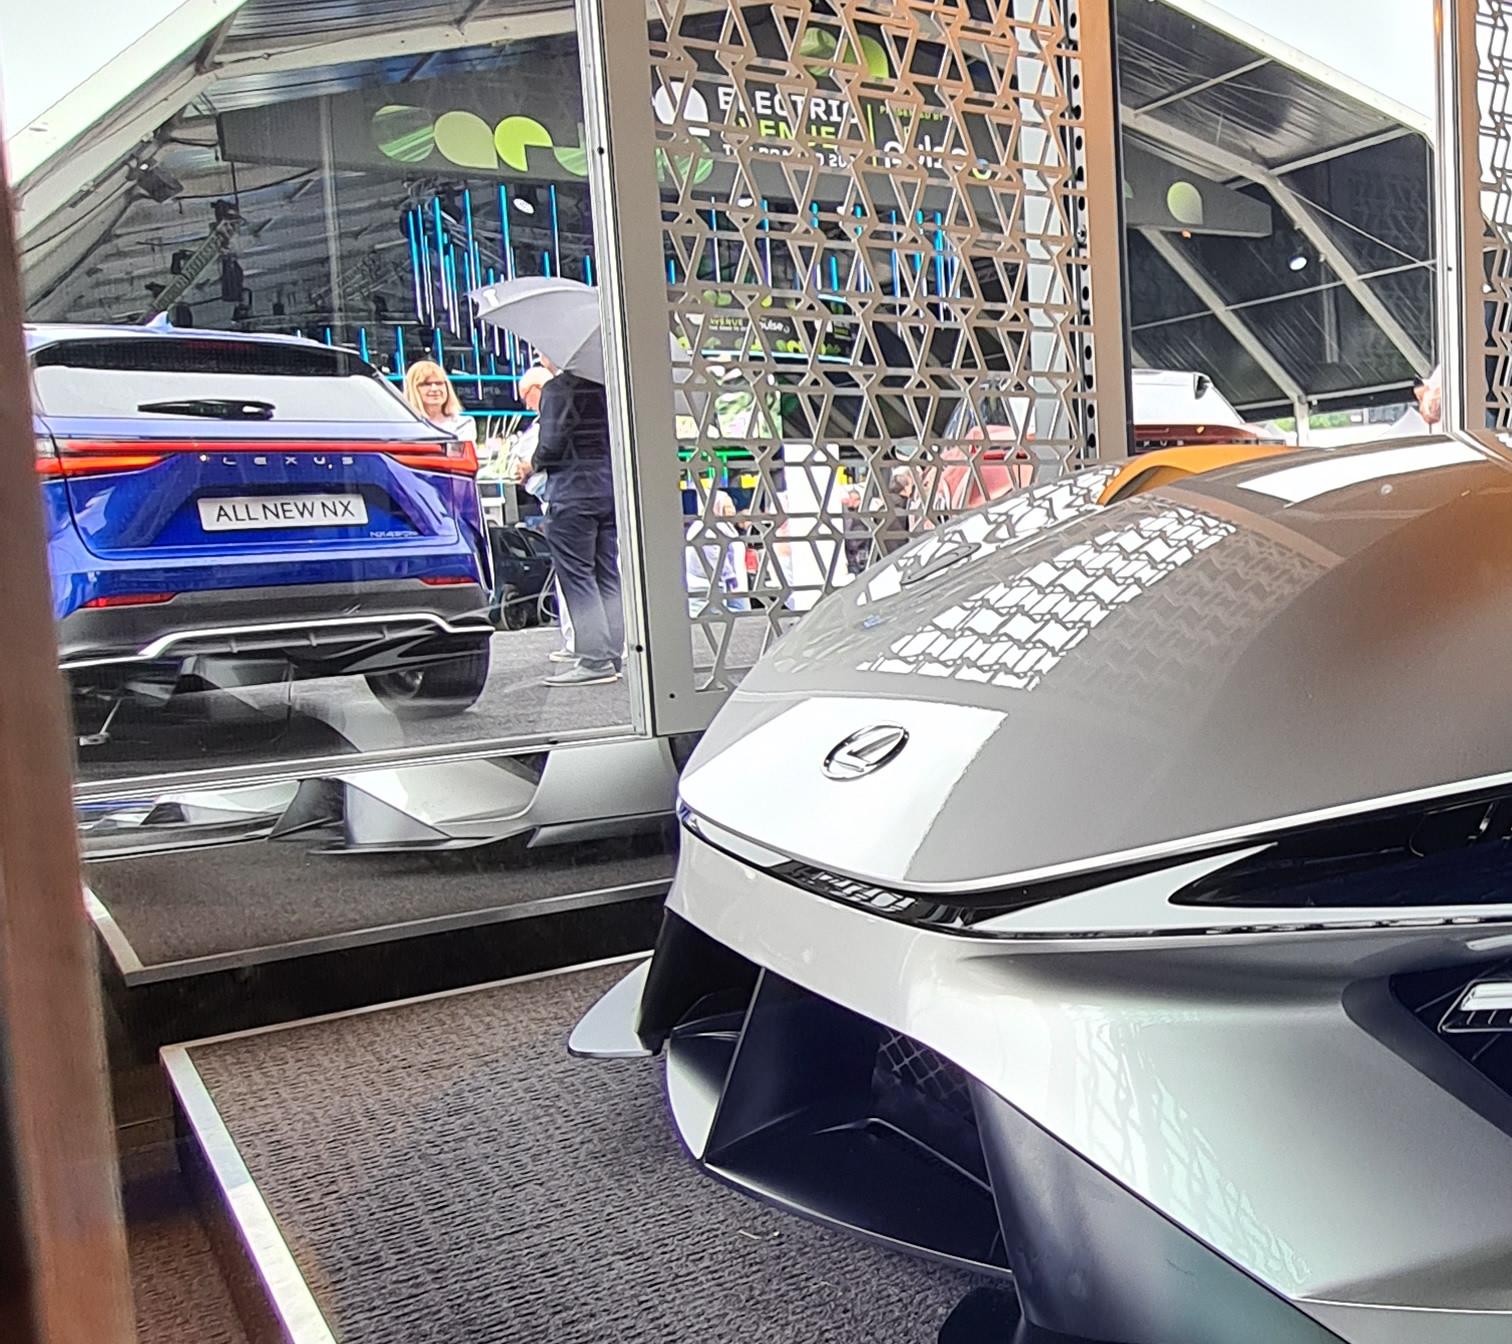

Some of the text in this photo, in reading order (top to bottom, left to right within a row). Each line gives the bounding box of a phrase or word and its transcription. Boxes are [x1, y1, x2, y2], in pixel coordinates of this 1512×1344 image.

[222, 456, 354, 465] LEXUS
[216, 500, 355, 522] ALL NEW NX
